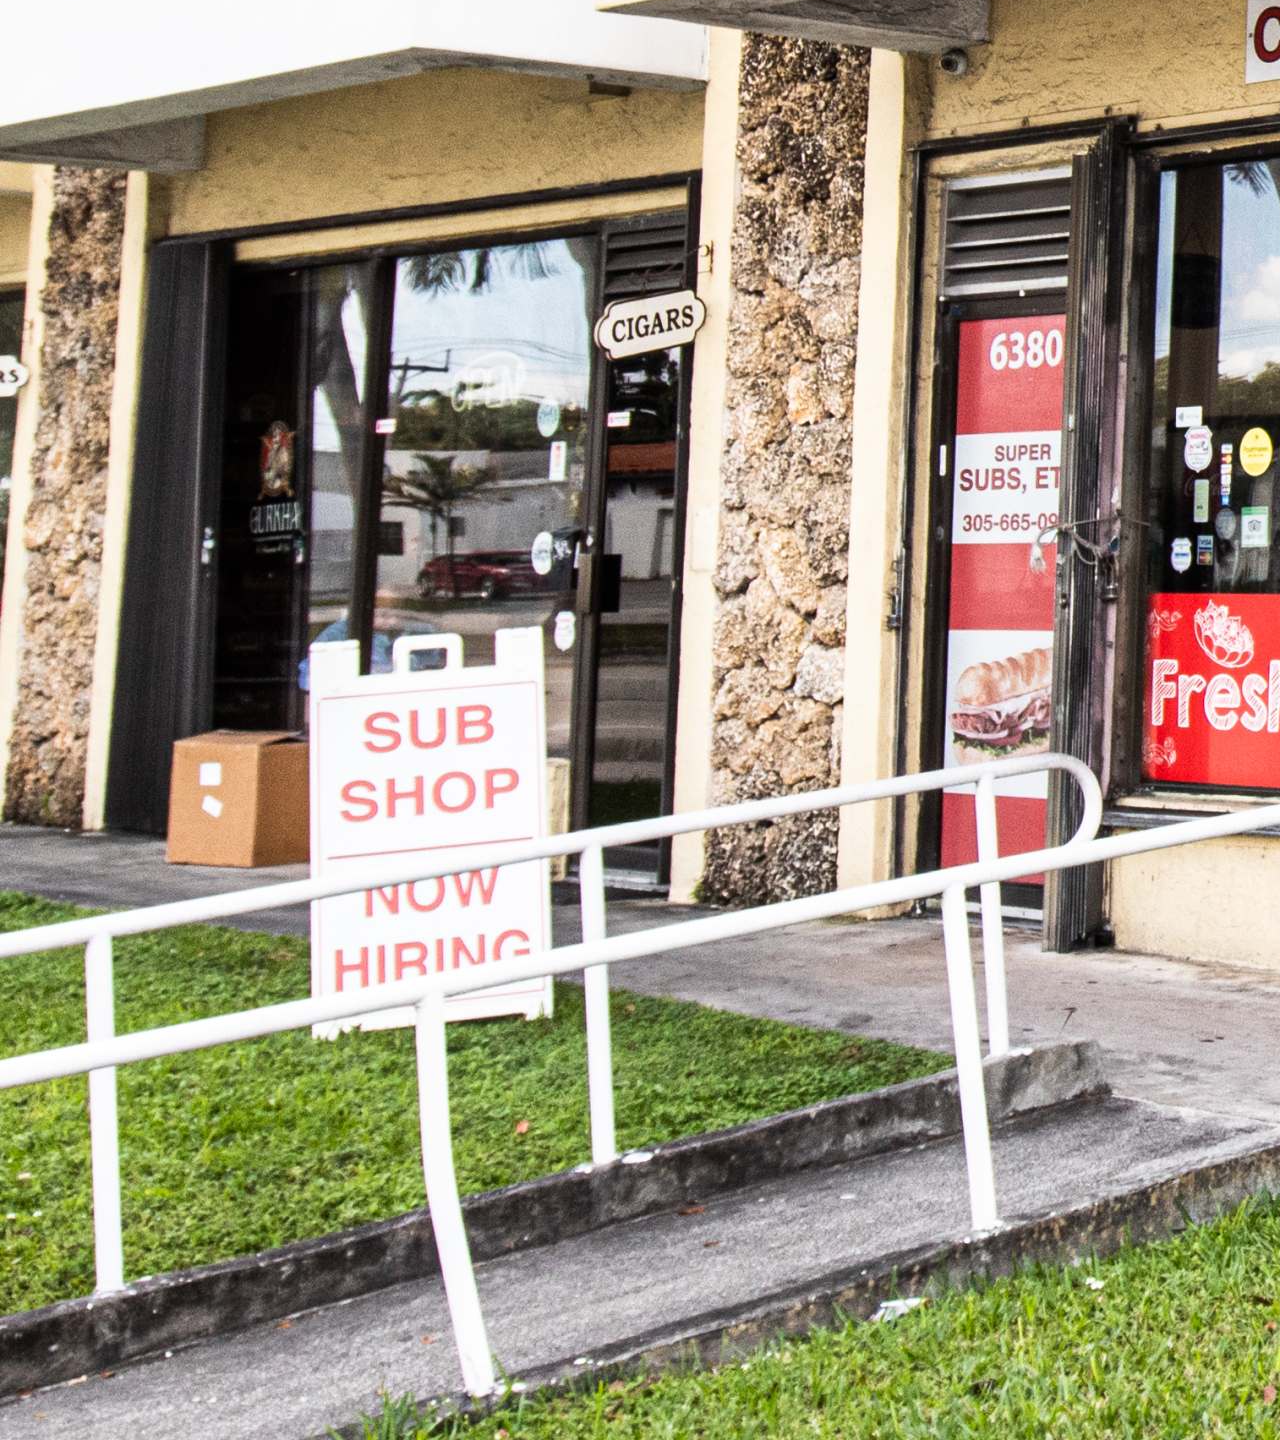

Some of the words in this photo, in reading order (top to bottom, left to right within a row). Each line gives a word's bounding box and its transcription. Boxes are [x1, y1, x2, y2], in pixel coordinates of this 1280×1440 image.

[612, 305, 694, 342] CIGARS
[990, 329, 1063, 371] 6380
[994, 444, 1051, 461] SUPER
[959, 467, 1027, 493] SUBS,
[1035, 466, 1060, 489] ET
[963, 513, 1059, 532] 305-665-09
[363, 704, 495, 753] SUB
[340, 768, 520, 822] SHOP
[364, 865, 500, 918] NOW
[335, 928, 530, 992] HIRING
